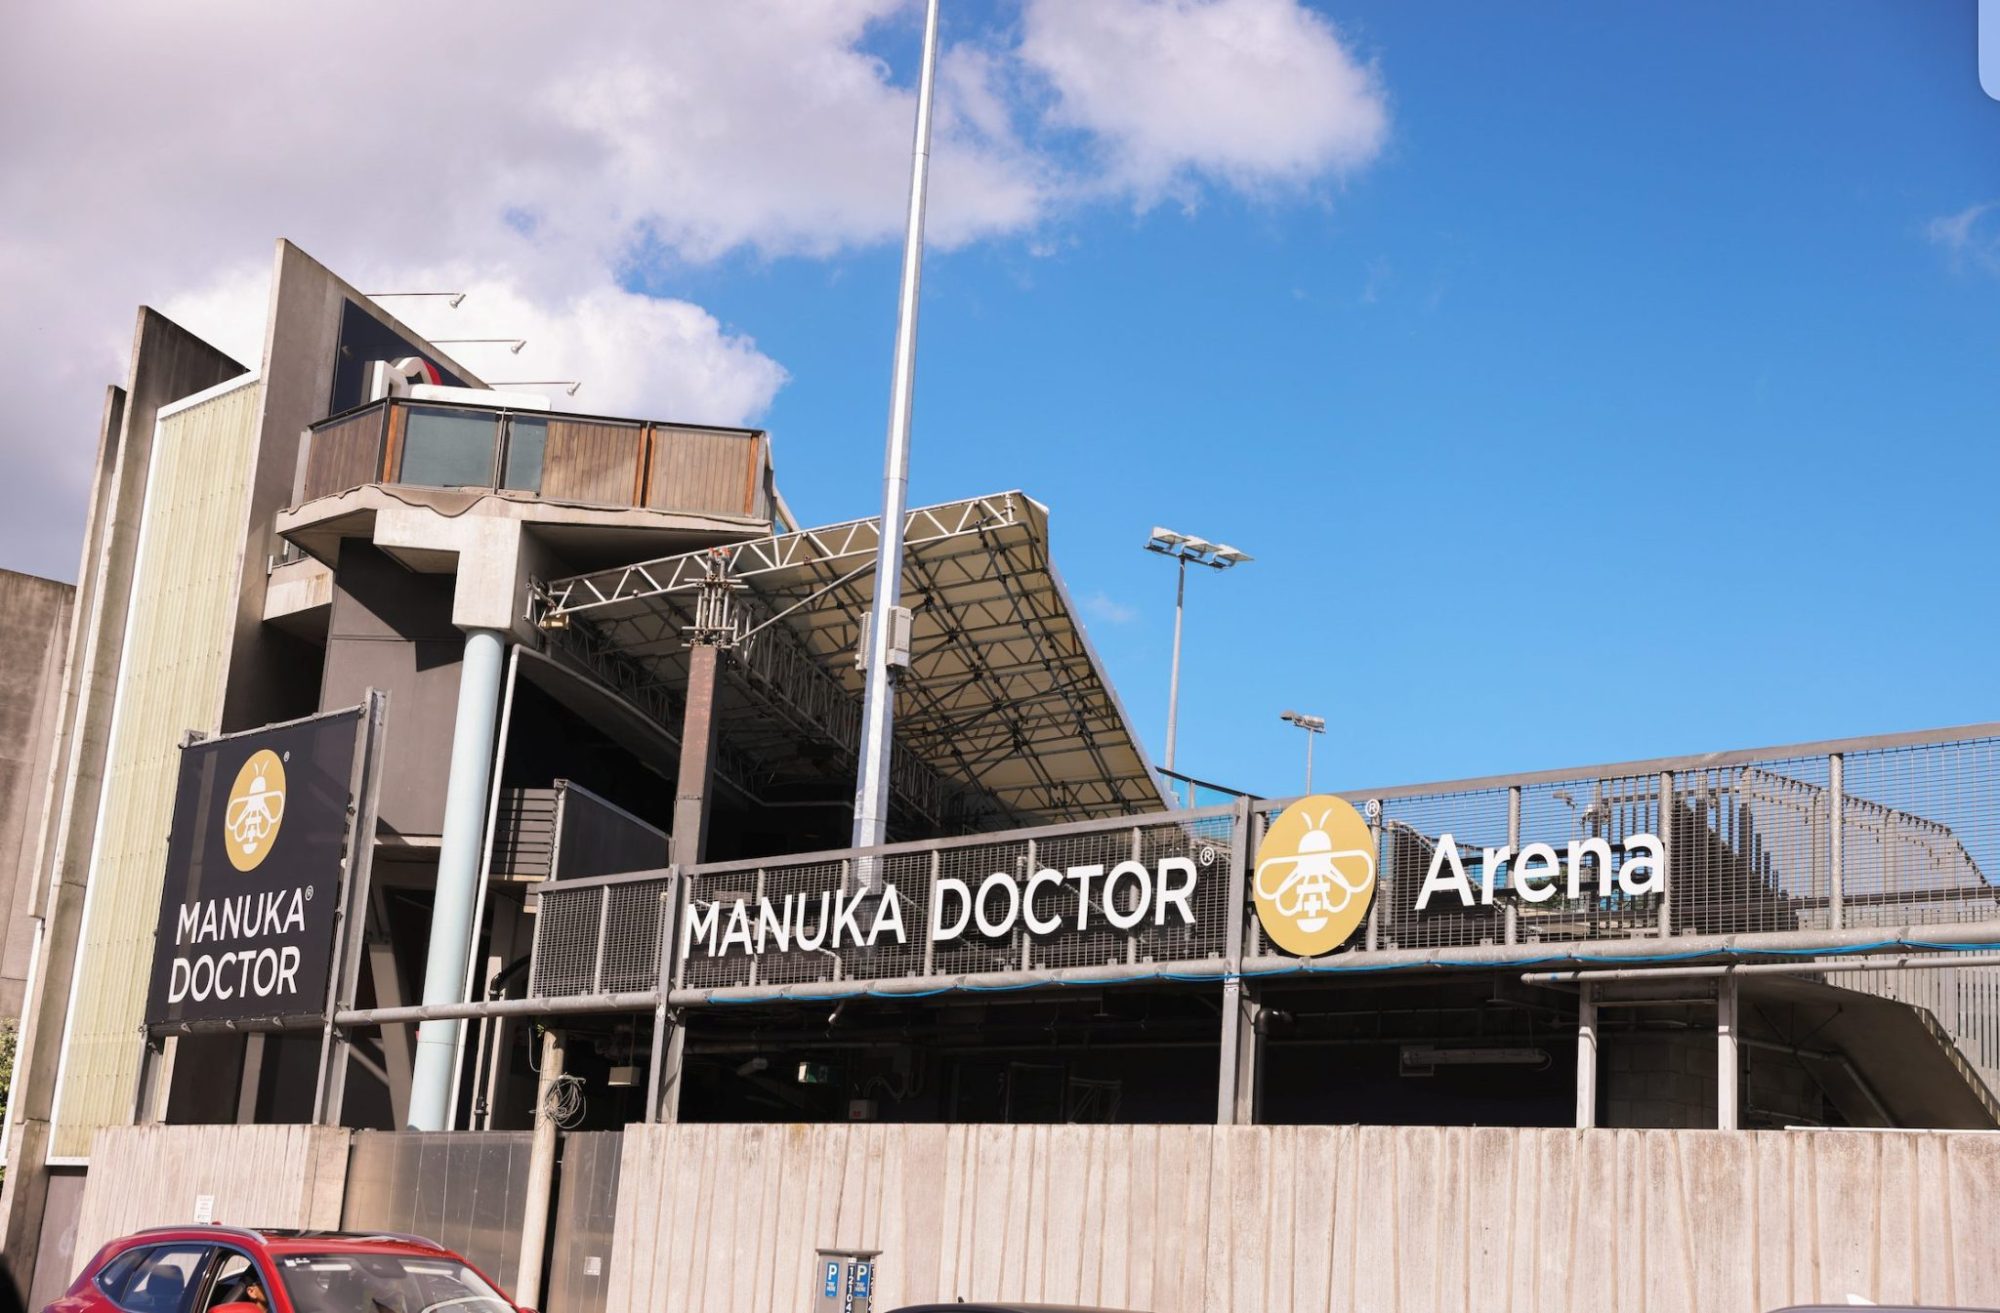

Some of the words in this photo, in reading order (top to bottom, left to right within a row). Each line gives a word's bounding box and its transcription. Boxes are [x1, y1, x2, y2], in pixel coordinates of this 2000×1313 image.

[1414, 833, 1665, 910] Arena
[682, 884, 907, 960] MANUKA
[167, 945, 301, 1004] DOCTOR
[828, 1264, 838, 1280] P
[845, 1266, 854, 1313] 12104
[856, 1264, 867, 1281] P
